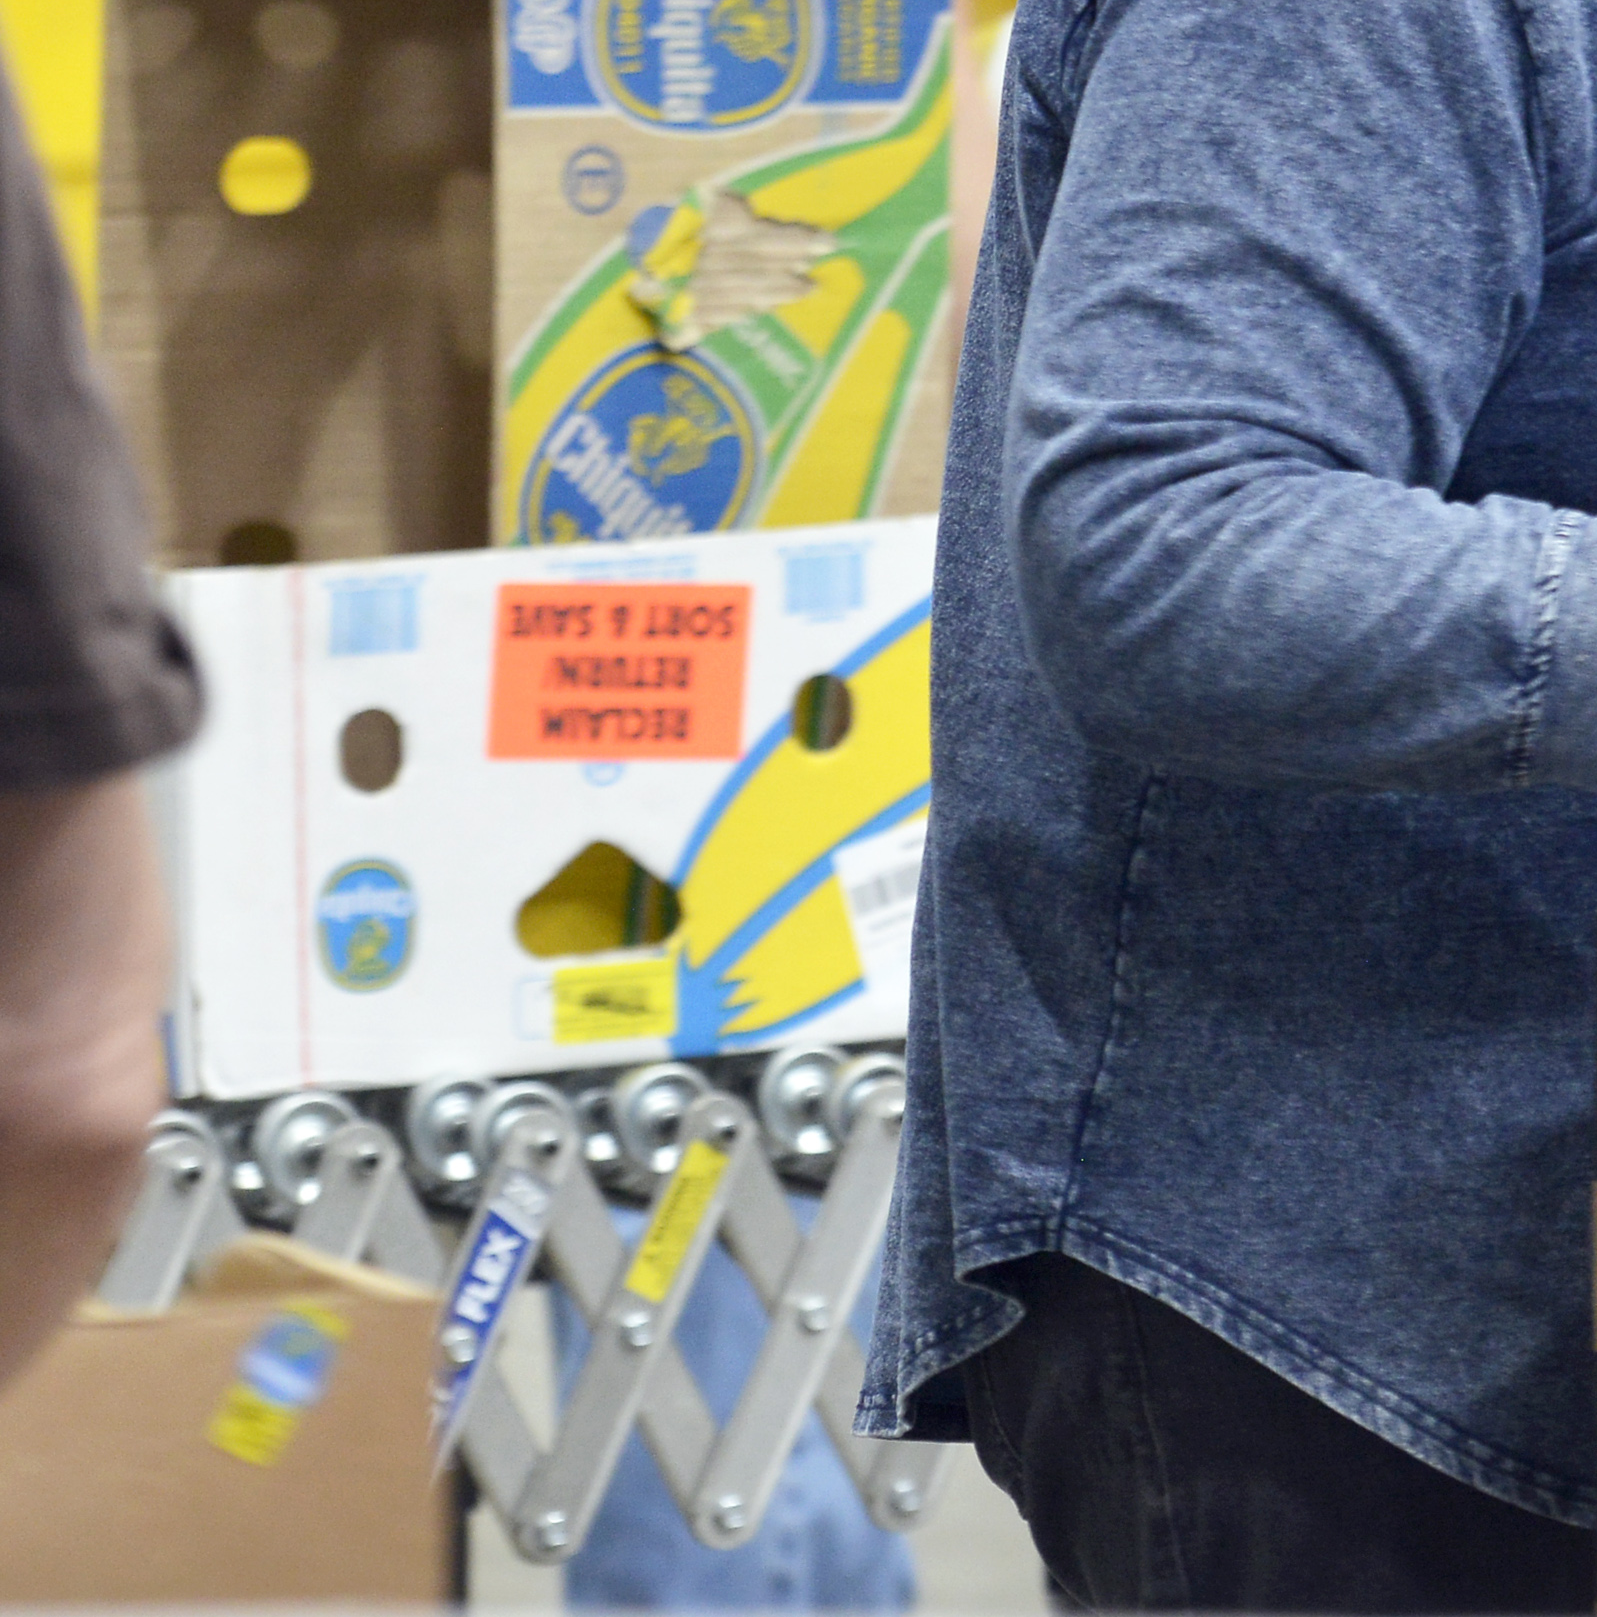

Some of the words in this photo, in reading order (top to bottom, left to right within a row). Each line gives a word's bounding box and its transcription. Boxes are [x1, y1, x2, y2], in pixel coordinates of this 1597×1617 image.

[546, 411, 697, 540] Chiqui
[512, 605, 593, 637] SAVE
[612, 605, 631, 637] &
[648, 605, 735, 637] SORT
[541, 707, 690, 740] RECLAIM
[456, 1229, 522, 1323] FLEX
